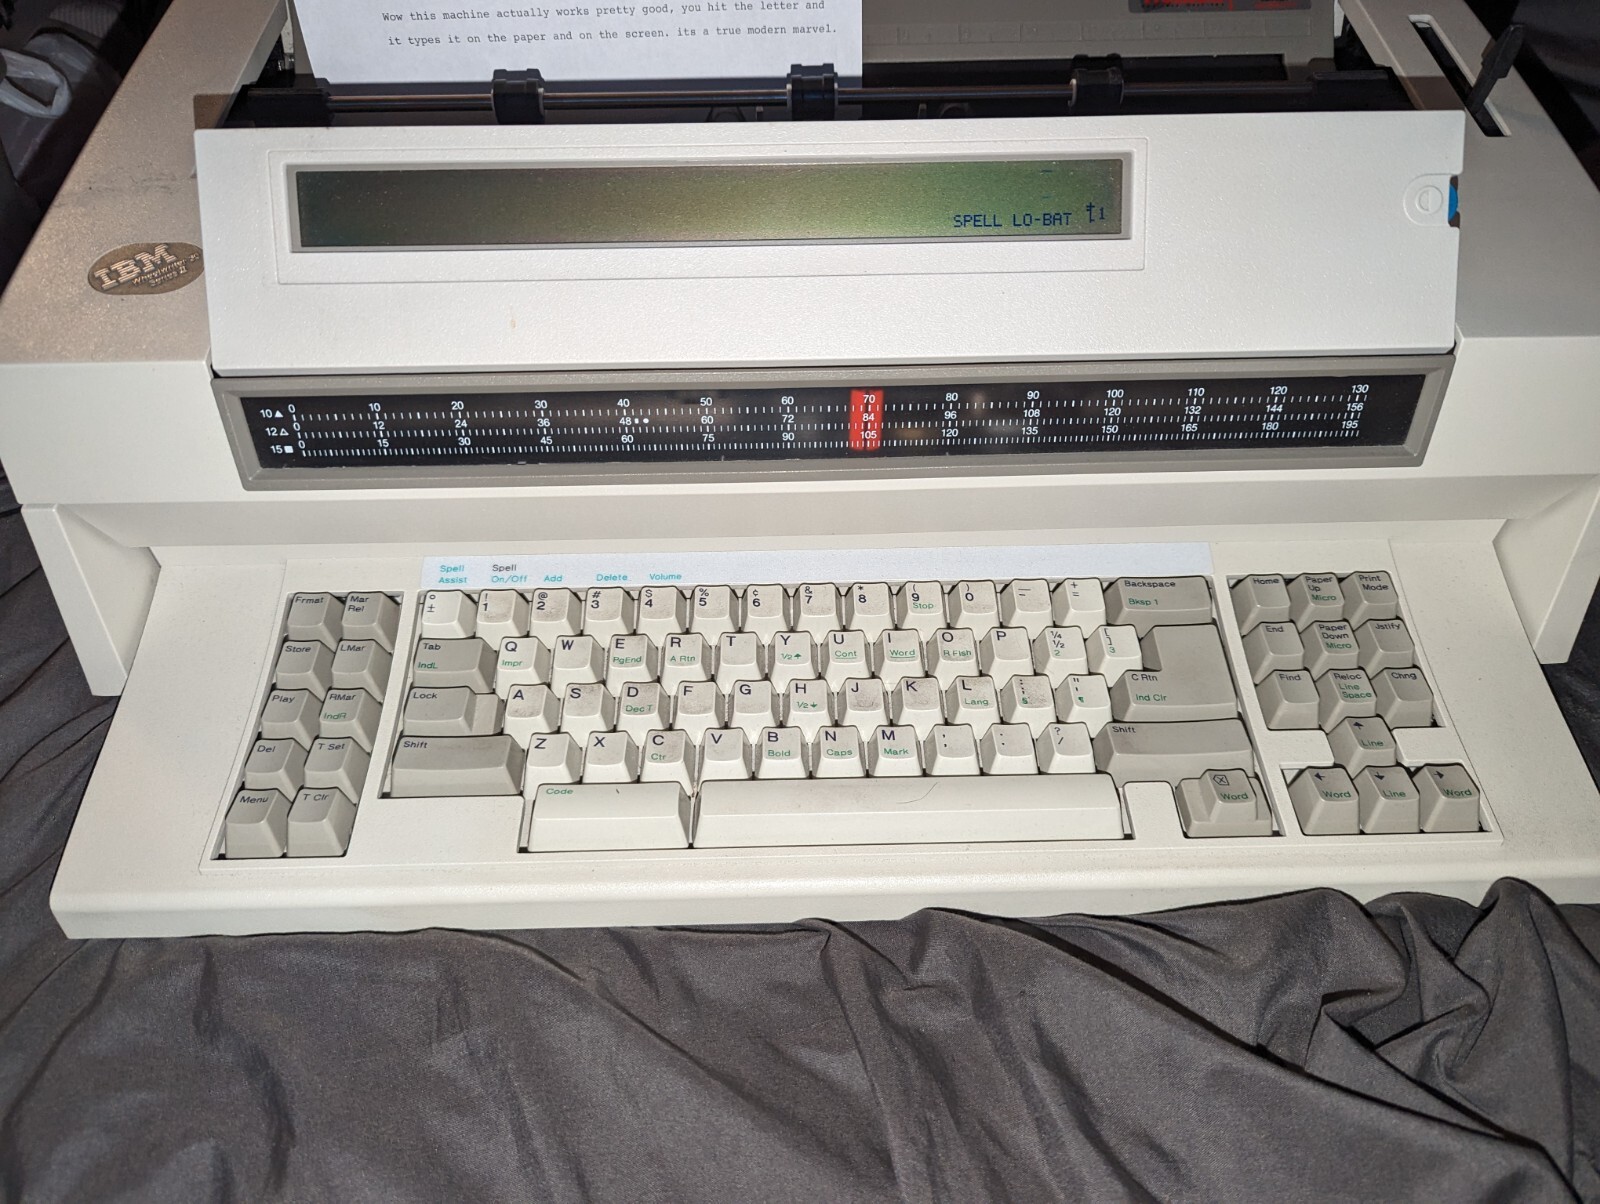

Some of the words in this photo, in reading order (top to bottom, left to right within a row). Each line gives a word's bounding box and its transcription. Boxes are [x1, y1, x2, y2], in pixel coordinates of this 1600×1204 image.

[382, 12, 402, 22] Wow
[410, 12, 436, 21] this
[442, 10, 490, 20] machine
[496, 8, 550, 20] actually
[556, 6, 590, 16] works
[596, 5, 636, 17] pretty
[642, 4, 674, 16] good,
[681, 4, 701, 14] you
[707, 2, 728, 12] hit
[734, 1, 754, 10] the
[760, 0, 800, 10] letter
[805, 0, 825, 10] and
[388, 36, 402, 46] it
[408, 35, 441, 46] types
[448, 34, 461, 44] it
[467, 35, 481, 44] on
[487, 33, 507, 43] the
[513, 32, 546, 44] paper
[552, 31, 572, 41] and
[578, 32, 592, 40] on
[599, 30, 618, 40] the
[624, 28, 670, 39] screen.
[677, 28, 696, 37] its
[716, 26, 742, 36] true
[747, 25, 786, 35] modern
[792, 24, 837, 34] marvel.
[954, 214, 1002, 228] SPELL
[1012, 212, 1072, 227] LO-BAT
[94, 243, 178, 291] IBM
[368, 402, 382, 412] 10
[450, 400, 464, 412] 20
[534, 400, 548, 410] 30
[616, 398, 630, 408] 40
[700, 398, 713, 407] 50
[780, 396, 794, 406] 60
[862, 394, 876, 404] 70
[945, 392, 958, 402] 80
[1026, 390, 1040, 400] 90
[1106, 388, 1124, 398] 100
[1187, 388, 1206, 396] 110
[1269, 386, 1288, 396] 120
[1350, 384, 1370, 394] 130
[260, 409, 272, 418] 10
[372, 420, 386, 430] 12
[454, 418, 468, 428] 24
[537, 418, 551, 428] 36
[618, 416, 632, 426] 48
[700, 415, 714, 425] 60
[782, 414, 794, 424] 72
[862, 412, 875, 422] 84
[944, 410, 957, 420] 96
[1022, 408, 1040, 418] 108
[1104, 407, 1122, 416] 120
[1184, 405, 1202, 415] 132
[1265, 404, 1284, 414] 144
[1346, 402, 1364, 412] 156
[265, 426, 278, 436] 12
[377, 438, 390, 448] 15
[458, 436, 472, 446] 30
[540, 436, 553, 446] 45
[620, 434, 634, 444] 60
[702, 433, 715, 443] 75
[782, 432, 795, 442] 90
[860, 430, 878, 440] 105
[941, 428, 958, 438] 120
[1020, 426, 1038, 436] 135
[1100, 424, 1120, 434] 150
[1180, 423, 1198, 432] 165
[1260, 422, 1280, 431] 180
[1340, 420, 1358, 430] 195
[270, 444, 283, 454] 15
[440, 564, 465, 574] Spell
[492, 564, 517, 572] Spell
[438, 576, 468, 584] Assist
[490, 574, 528, 584] On/Off
[544, 574, 563, 583] Add
[596, 574, 628, 582] Delete
[649, 572, 682, 582] Volume
[1305, 576, 1333, 584] Paper
[1124, 580, 1176, 588] Backspace
[1308, 585, 1321, 593] Up
[350, 595, 370, 603] Mar
[1128, 598, 1152, 606] Bksp
[348, 604, 364, 612] Rel
[912, 602, 934, 610] Stop
[1318, 624, 1348, 632] Paper
[941, 631, 954, 642] O
[422, 642, 442, 650] Tab
[504, 641, 518, 652] Q
[561, 640, 574, 650] W
[834, 650, 857, 658] Cont
[889, 648, 916, 656] Word
[612, 656, 642, 665] PgEnd
[680, 654, 696, 662] Rtn
[502, 660, 523, 668] Impr
[1140, 673, 1158, 681] Rtn
[1392, 672, 1417, 681] Chng
[739, 684, 752, 695] G
[272, 694, 296, 704] Play
[412, 692, 438, 700] Lock
[1135, 694, 1152, 702] Ind
[1154, 694, 1168, 702] Clr
[1342, 692, 1372, 700] Space
[964, 698, 989, 706] Lang
[625, 704, 644, 713] Dec
[1112, 725, 1136, 734] Shift
[882, 730, 896, 740] M
[402, 740, 428, 748] Shift
[1362, 739, 1384, 748] Line
[768, 749, 790, 757] Bold
[826, 748, 852, 757] Caps
[884, 747, 909, 756] Mark
[1220, 792, 1248, 800] Word
[1322, 790, 1352, 798] Word
[1444, 788, 1472, 796] Word
[239, 796, 269, 804] Menu
